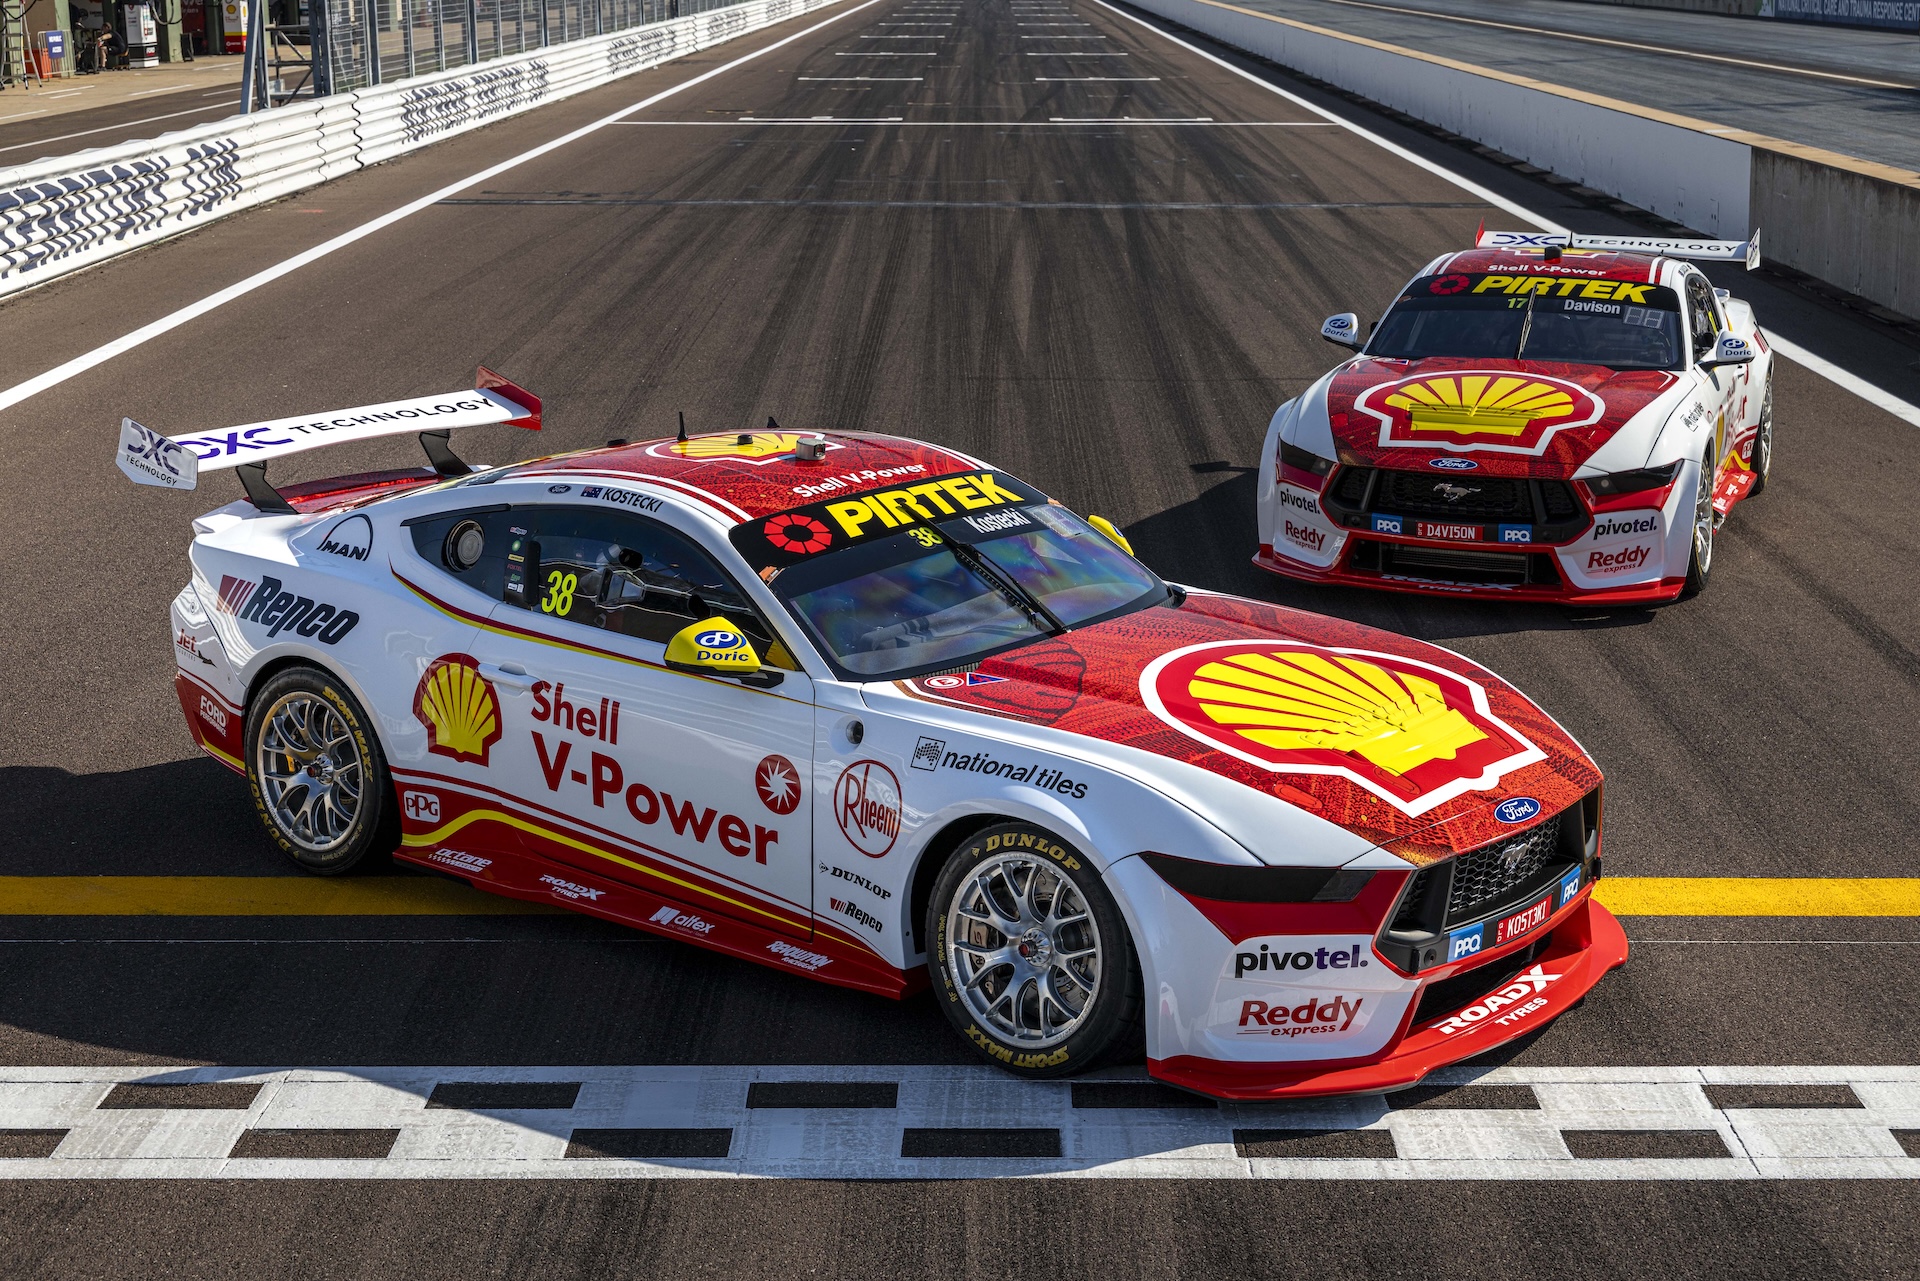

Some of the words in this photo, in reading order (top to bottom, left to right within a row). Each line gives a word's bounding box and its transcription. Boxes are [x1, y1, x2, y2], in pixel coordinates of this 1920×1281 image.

[1823, 0, 1838, 16] CARE
[1838, 0, 1849, 16] AND
[1850, 0, 1872, 18] TRAUMA
[1873, 2, 1903, 20] RESPONSE
[1575, 238, 1737, 252] TECHNOLOGY
[1534, 265, 1607, 276] V-Power
[1472, 275, 1656, 304] PIRTEK
[1507, 298, 1528, 308] 17
[1564, 299, 1621, 315] Davison
[1324, 328, 1348, 338] Doric
[288, 396, 494, 434] TECHNOLOGY
[126, 454, 177, 487] TECHNOLOGY
[1437, 458, 1468, 468] Ford
[793, 475, 844, 498] Shell
[847, 462, 927, 490] V-Power
[602, 488, 664, 512] KOSTECKI
[825, 474, 1025, 538] PIRTEK
[1280, 488, 1320, 514] pivotel.
[963, 507, 1032, 534] Kostecki
[1376, 520, 1400, 534] PPQ
[1593, 516, 1657, 540] pivotel.
[905, 525, 944, 550] 38
[1286, 520, 1326, 552] Reddy
[1295, 540, 1316, 550] express
[1504, 531, 1530, 542] PPQ
[320, 540, 366, 560] MAN
[1588, 546, 1651, 569] Reddy
[1603, 562, 1636, 574] express
[541, 570, 578, 616] 38
[240, 575, 360, 646] Repco
[696, 650, 750, 662] Doric
[200, 695, 227, 729] FORD
[322, 686, 360, 728] SPORT
[530, 680, 620, 745] Shell
[942, 751, 1038, 784] national
[1036, 768, 1088, 800] tiles
[248, 766, 293, 852] DUNLOP
[406, 795, 438, 818] PPG
[530, 730, 779, 866] V-Power
[842, 764, 898, 840] Rheem
[1502, 800, 1535, 822] Ford
[986, 833, 1082, 872] DUNLOP
[539, 874, 606, 900] ROADX
[552, 885, 580, 900] TYRES
[830, 866, 892, 900] DUNLOP
[1562, 878, 1579, 904] PPQ
[674, 914, 716, 934] alfex
[844, 900, 884, 934] Repco
[766, 940, 834, 967] REVOLUTION
[1454, 933, 1481, 959] PPQ
[1235, 944, 1368, 978] pivotel.
[1428, 963, 1564, 1036] ROADX
[1498, 996, 1549, 1028] TYRES
[1238, 996, 1364, 1032] Reddy
[964, 1024, 1010, 1064] MAXX
[1270, 1024, 1337, 1038] express
[1012, 1044, 1072, 1068] SPORT
